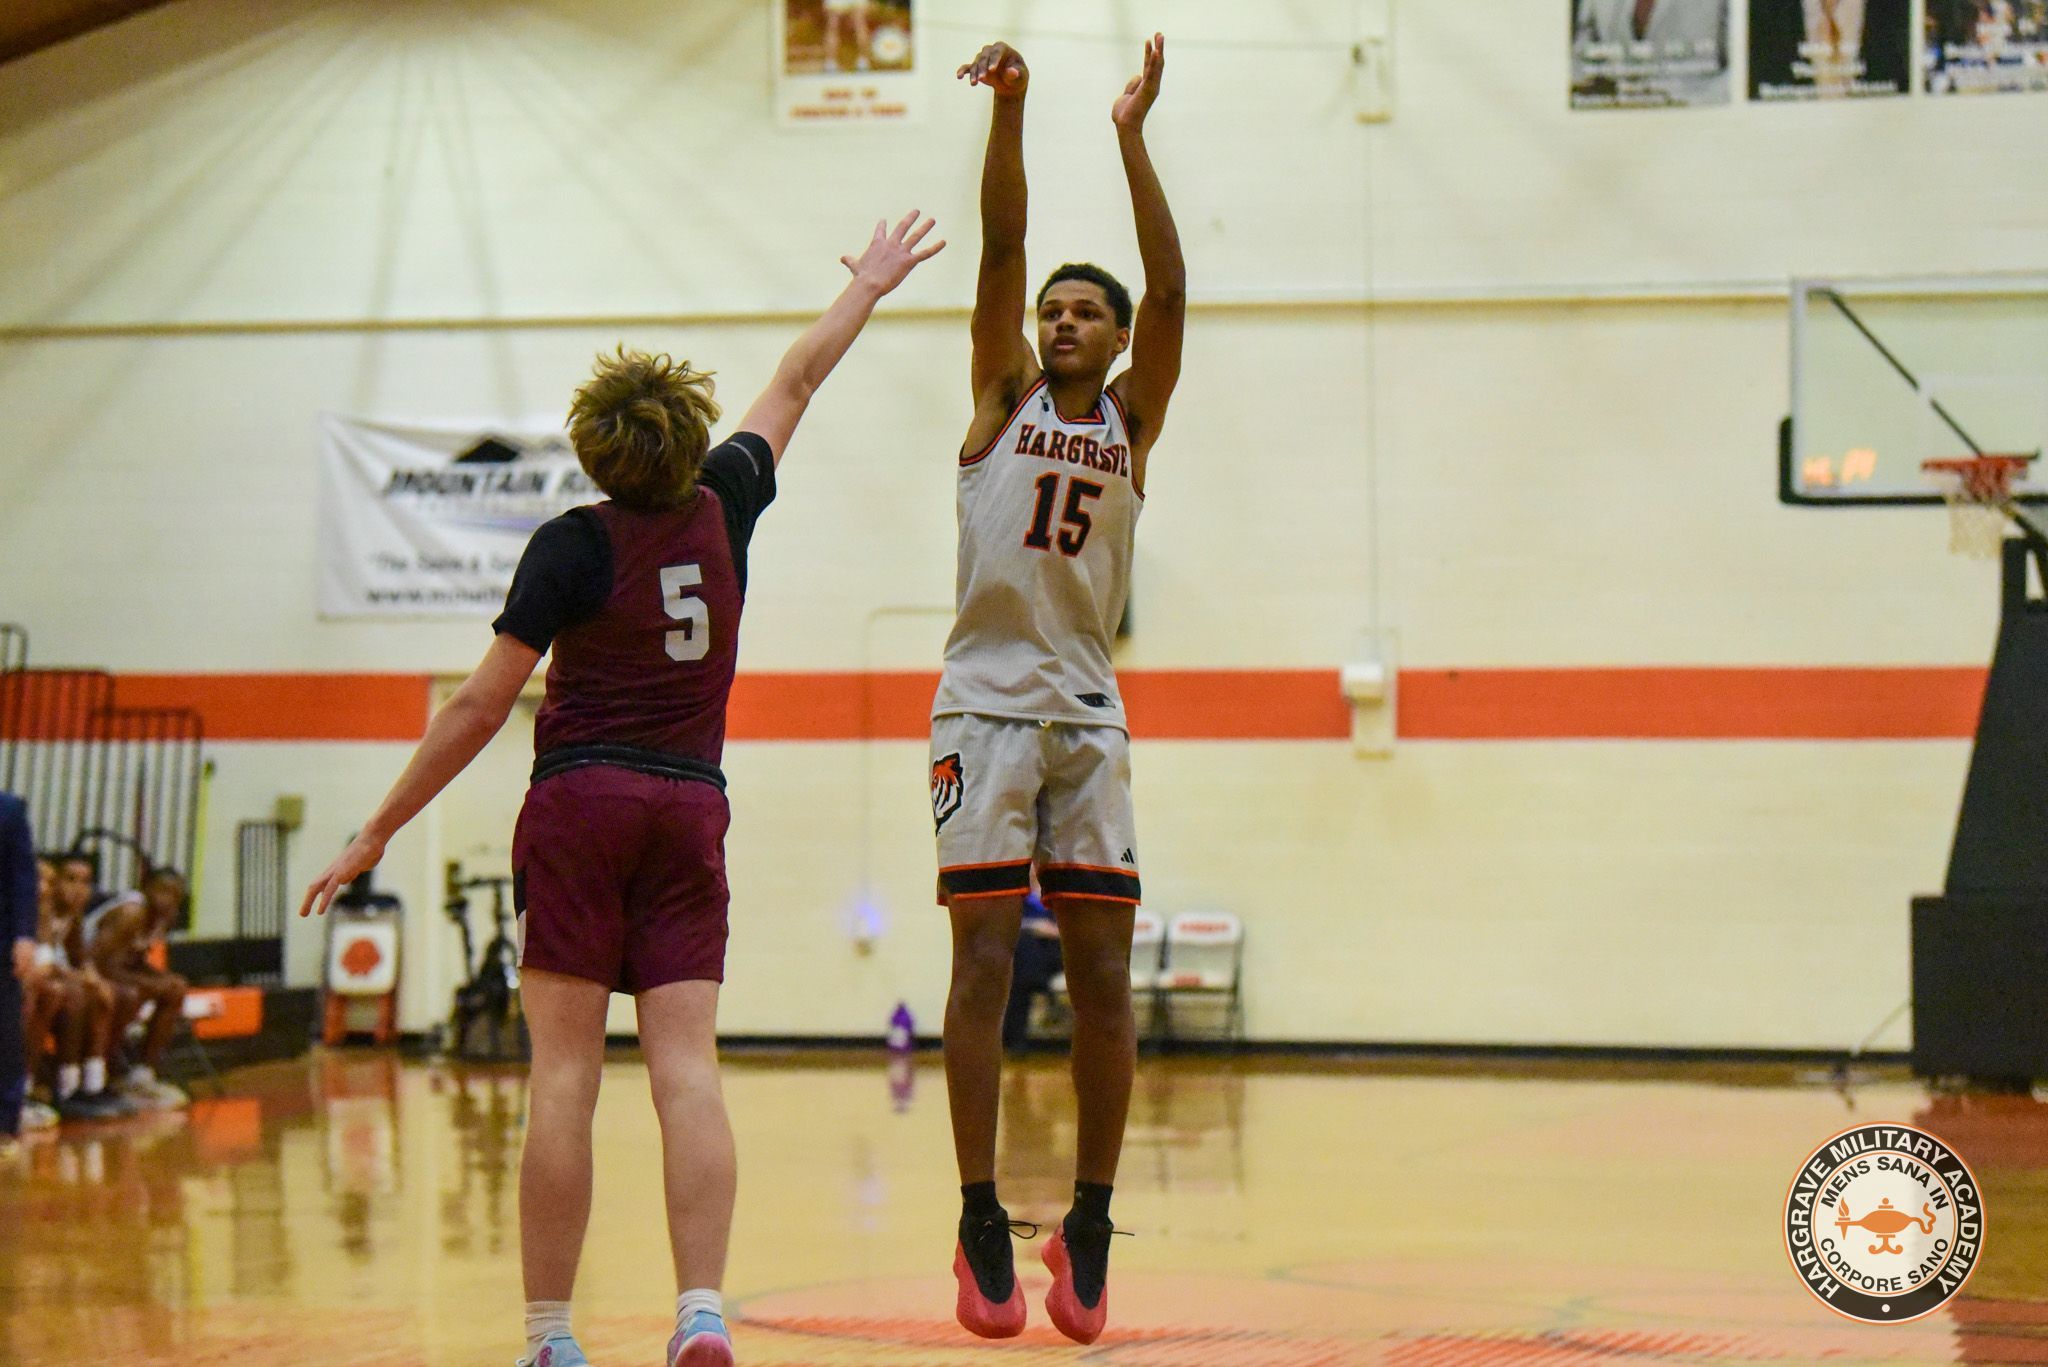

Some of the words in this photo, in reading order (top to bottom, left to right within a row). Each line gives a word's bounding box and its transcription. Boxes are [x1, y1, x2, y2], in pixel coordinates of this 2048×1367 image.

[1015, 424, 1128, 476] HARGRAVE
[1023, 471, 1105, 557] 15
[660, 563, 710, 662] 5
